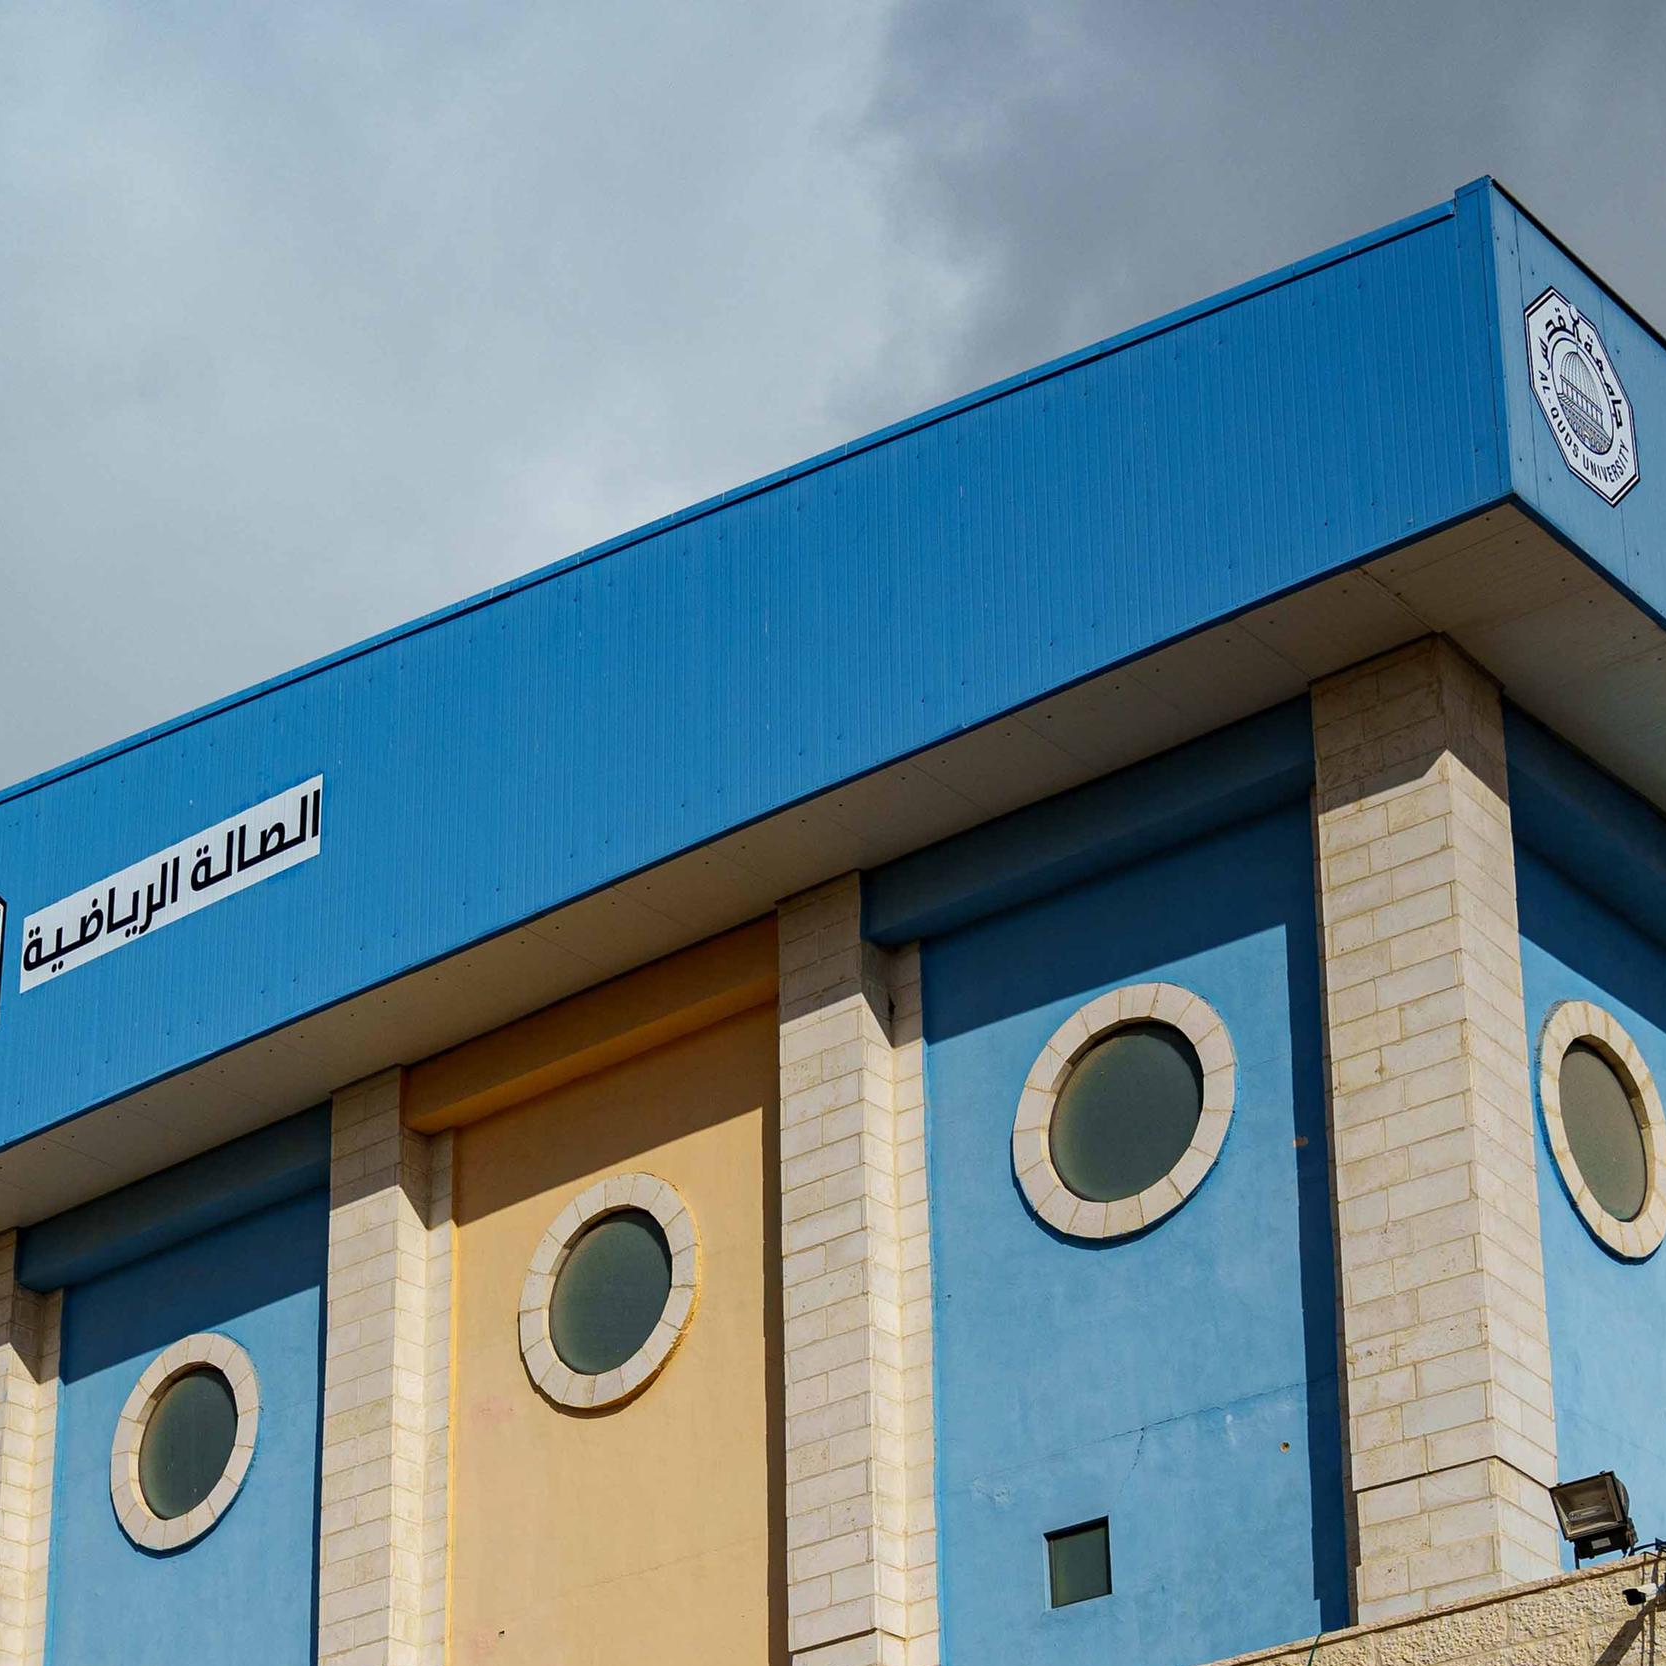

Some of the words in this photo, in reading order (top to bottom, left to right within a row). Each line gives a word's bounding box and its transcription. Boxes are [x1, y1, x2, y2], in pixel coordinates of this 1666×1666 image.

[1582, 438, 1630, 483] UNIVERSITY
[190, 788, 321, 892] الصالة
[23, 855, 181, 973] الرياضية
